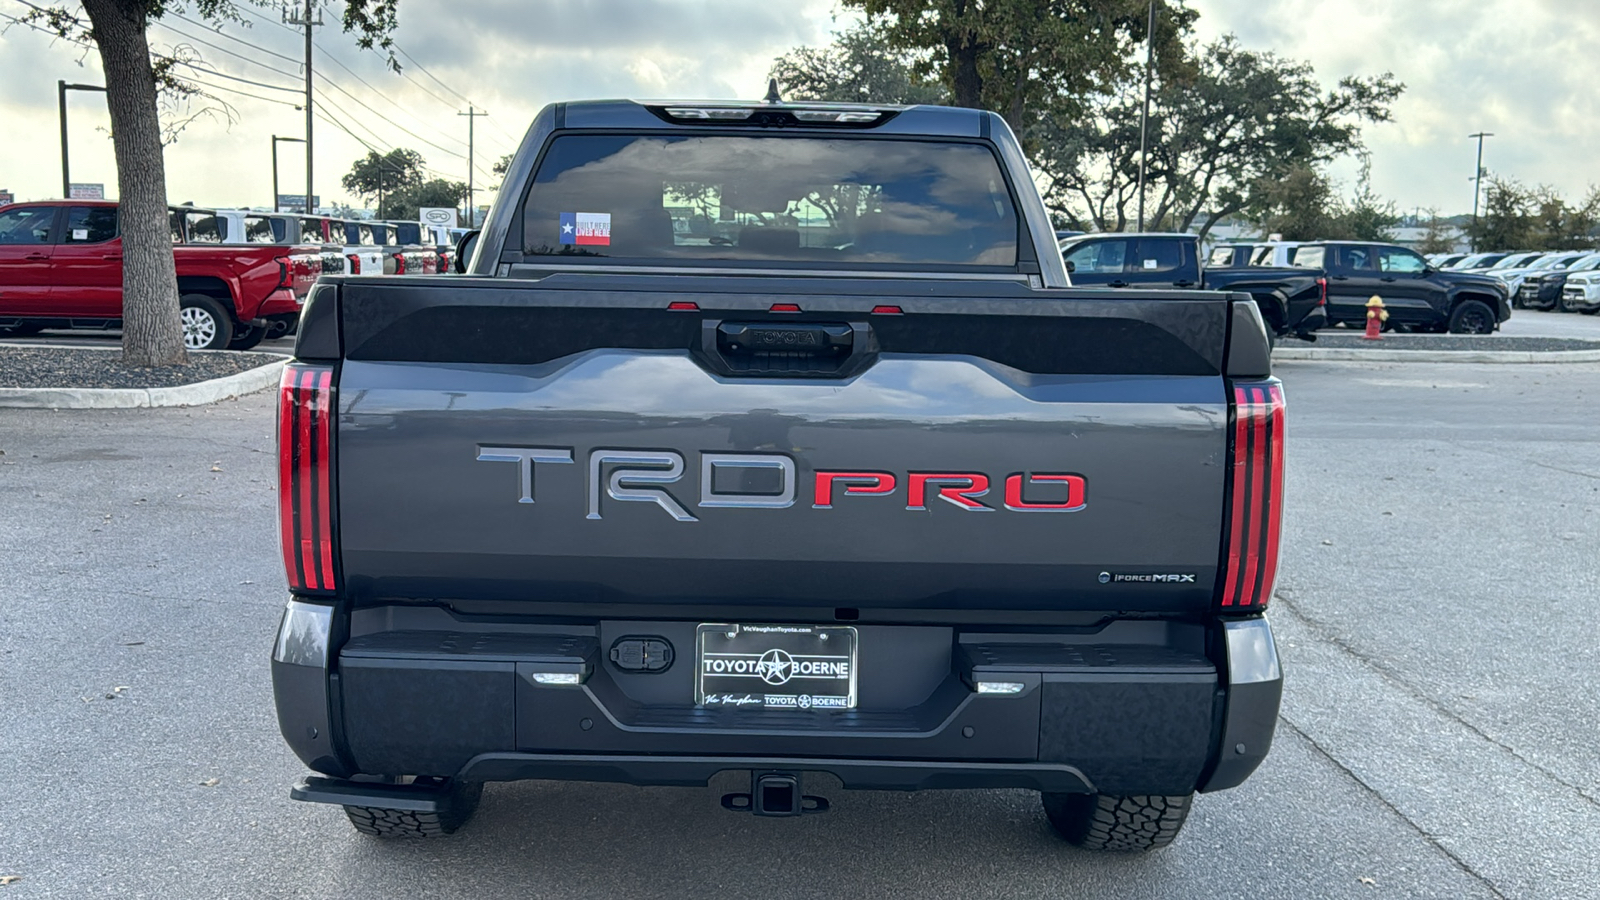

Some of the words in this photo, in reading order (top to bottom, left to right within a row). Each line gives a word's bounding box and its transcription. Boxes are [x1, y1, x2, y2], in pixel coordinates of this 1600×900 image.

[594, 222, 611, 230] HERE
[576, 228, 593, 236] LIVES
[594, 229, 611, 237] HERE
[754, 331, 815, 344] TOYOTA
[476, 444, 798, 522] TRD
[813, 468, 1088, 513] PRO
[704, 660, 766, 673] TOYOTA
[792, 661, 848, 675] BOERNE
[721, 694, 762, 706] Vaughan
[764, 697, 798, 705] TOYOTA
[812, 698, 847, 706] BOERNE
